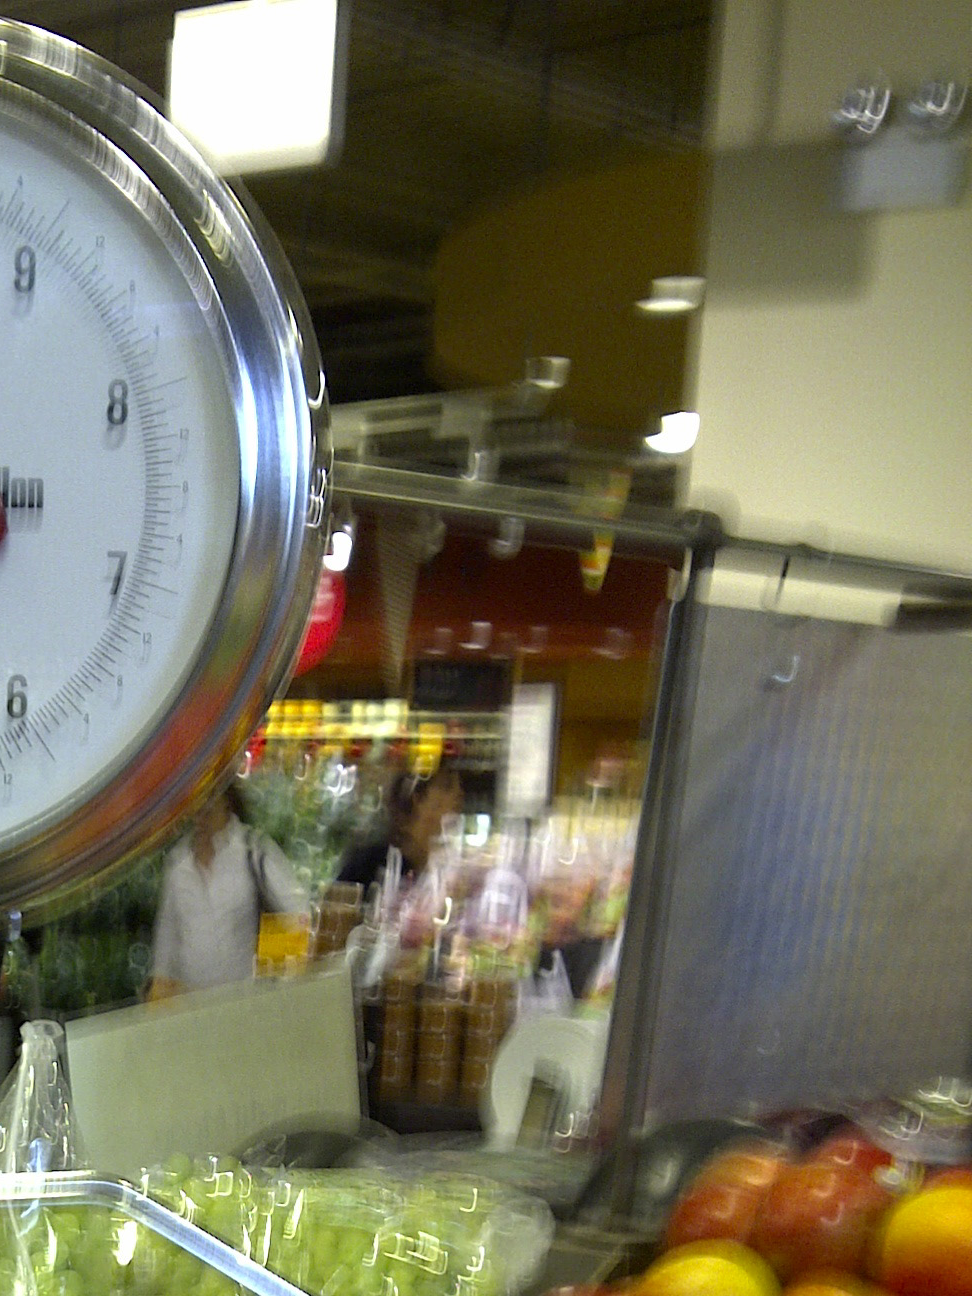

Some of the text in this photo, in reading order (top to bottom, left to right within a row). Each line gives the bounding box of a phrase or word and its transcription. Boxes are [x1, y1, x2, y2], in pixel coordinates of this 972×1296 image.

[13, 245, 36, 293] 9
[107, 378, 128, 425] 8
[107, 551, 127, 596] 7
[7, 674, 28, 718] 6
